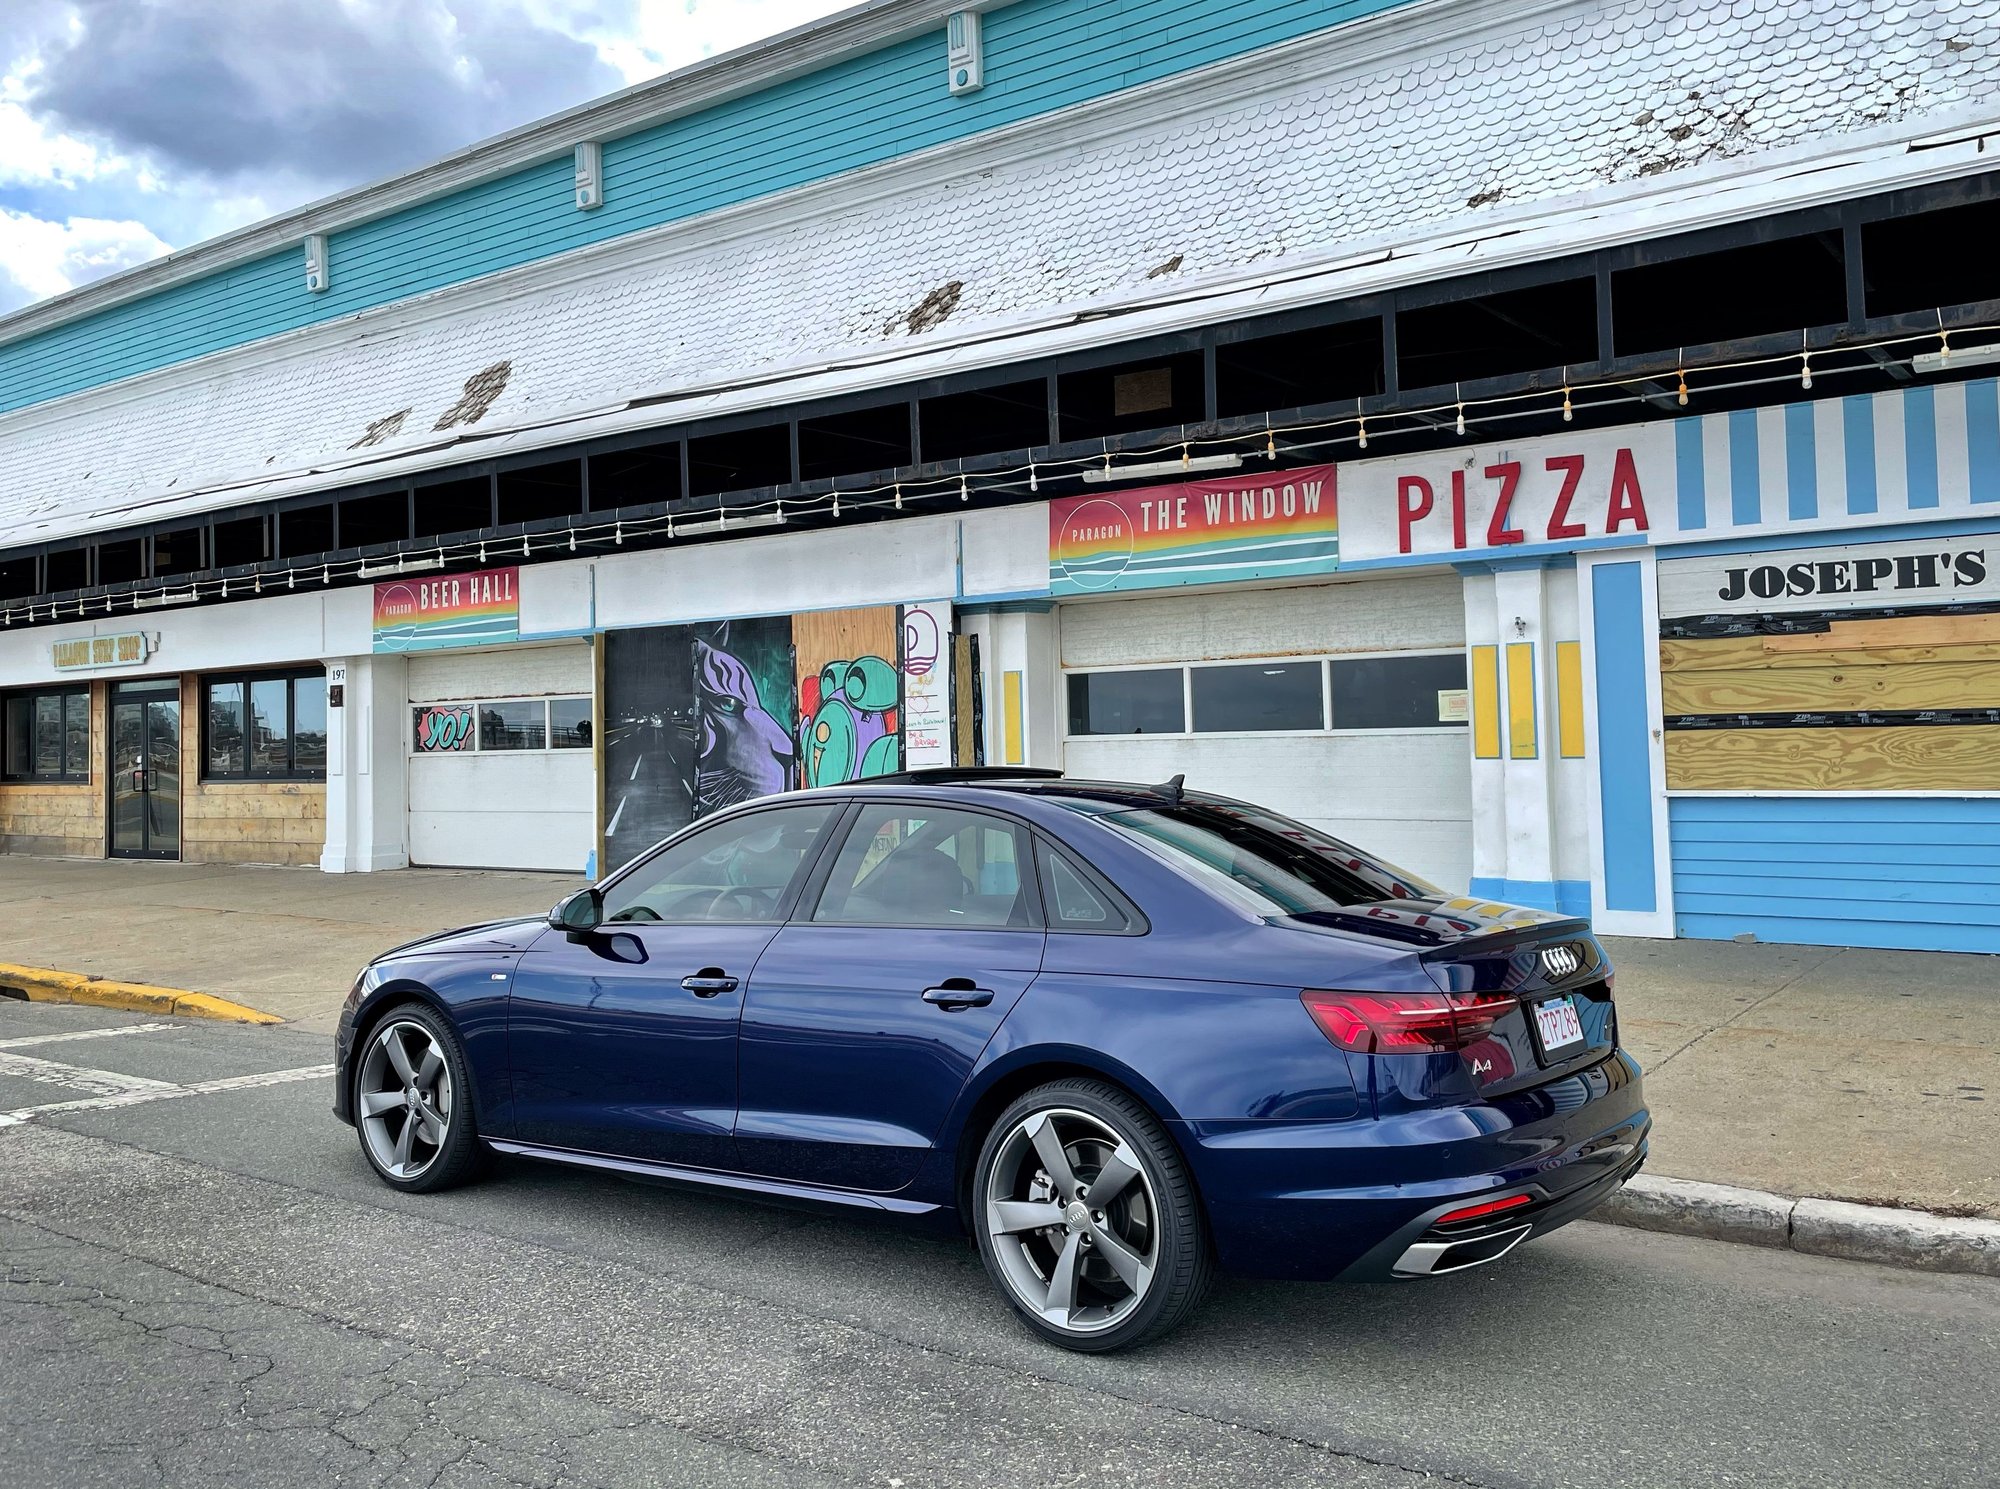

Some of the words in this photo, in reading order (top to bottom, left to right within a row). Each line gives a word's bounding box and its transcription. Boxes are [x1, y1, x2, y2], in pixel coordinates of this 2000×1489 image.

[1140, 497, 1188, 533] THE
[1203, 480, 1323, 526] WINDOW
[1397, 447, 1650, 554] PIZZA
[1072, 523, 1122, 543] PARAGON
[420, 580, 461, 610] BEER
[470, 573, 513, 605] HALL
[1717, 548, 1987, 602] JOSEPH'S
[385, 603, 413, 616] PARAGON
[332, 669, 346, 681] 197
[424, 711, 471, 751] YO!
[1471, 1058, 1493, 1076] A4
